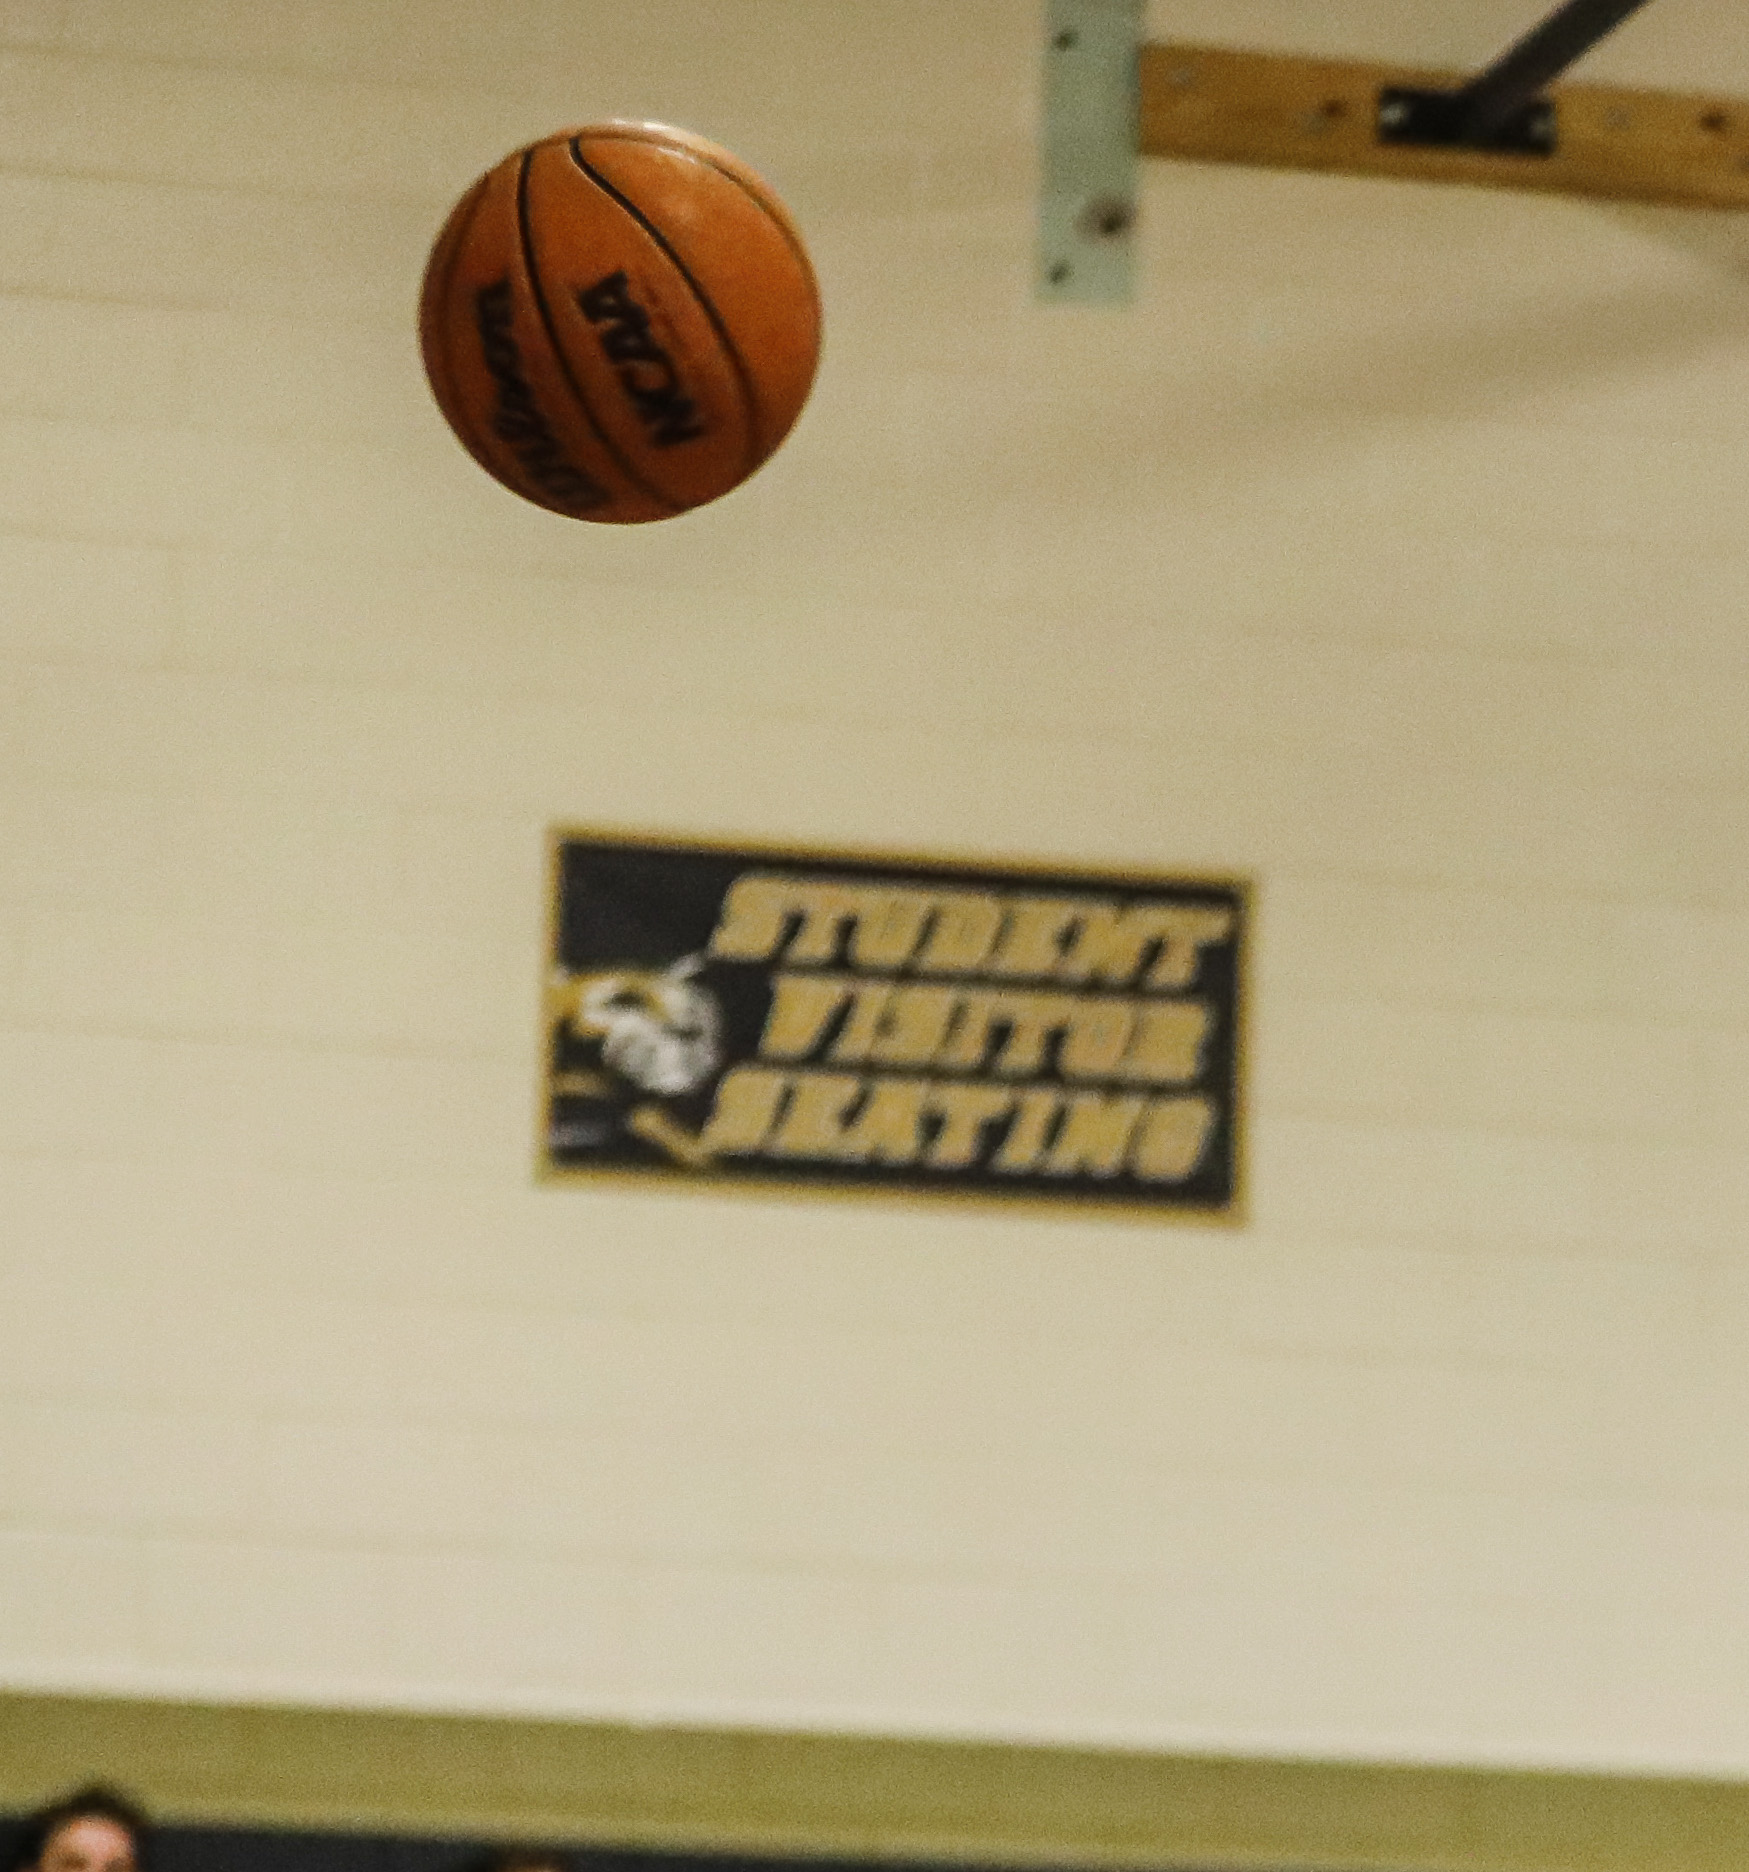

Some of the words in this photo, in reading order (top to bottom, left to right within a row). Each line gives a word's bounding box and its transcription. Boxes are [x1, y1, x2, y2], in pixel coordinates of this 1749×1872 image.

[577, 269, 706, 449] NCAA
[706, 874, 1231, 989] STUDENT
[758, 974, 1213, 1081] VISITOR
[701, 1065, 1213, 1181] SEATING
